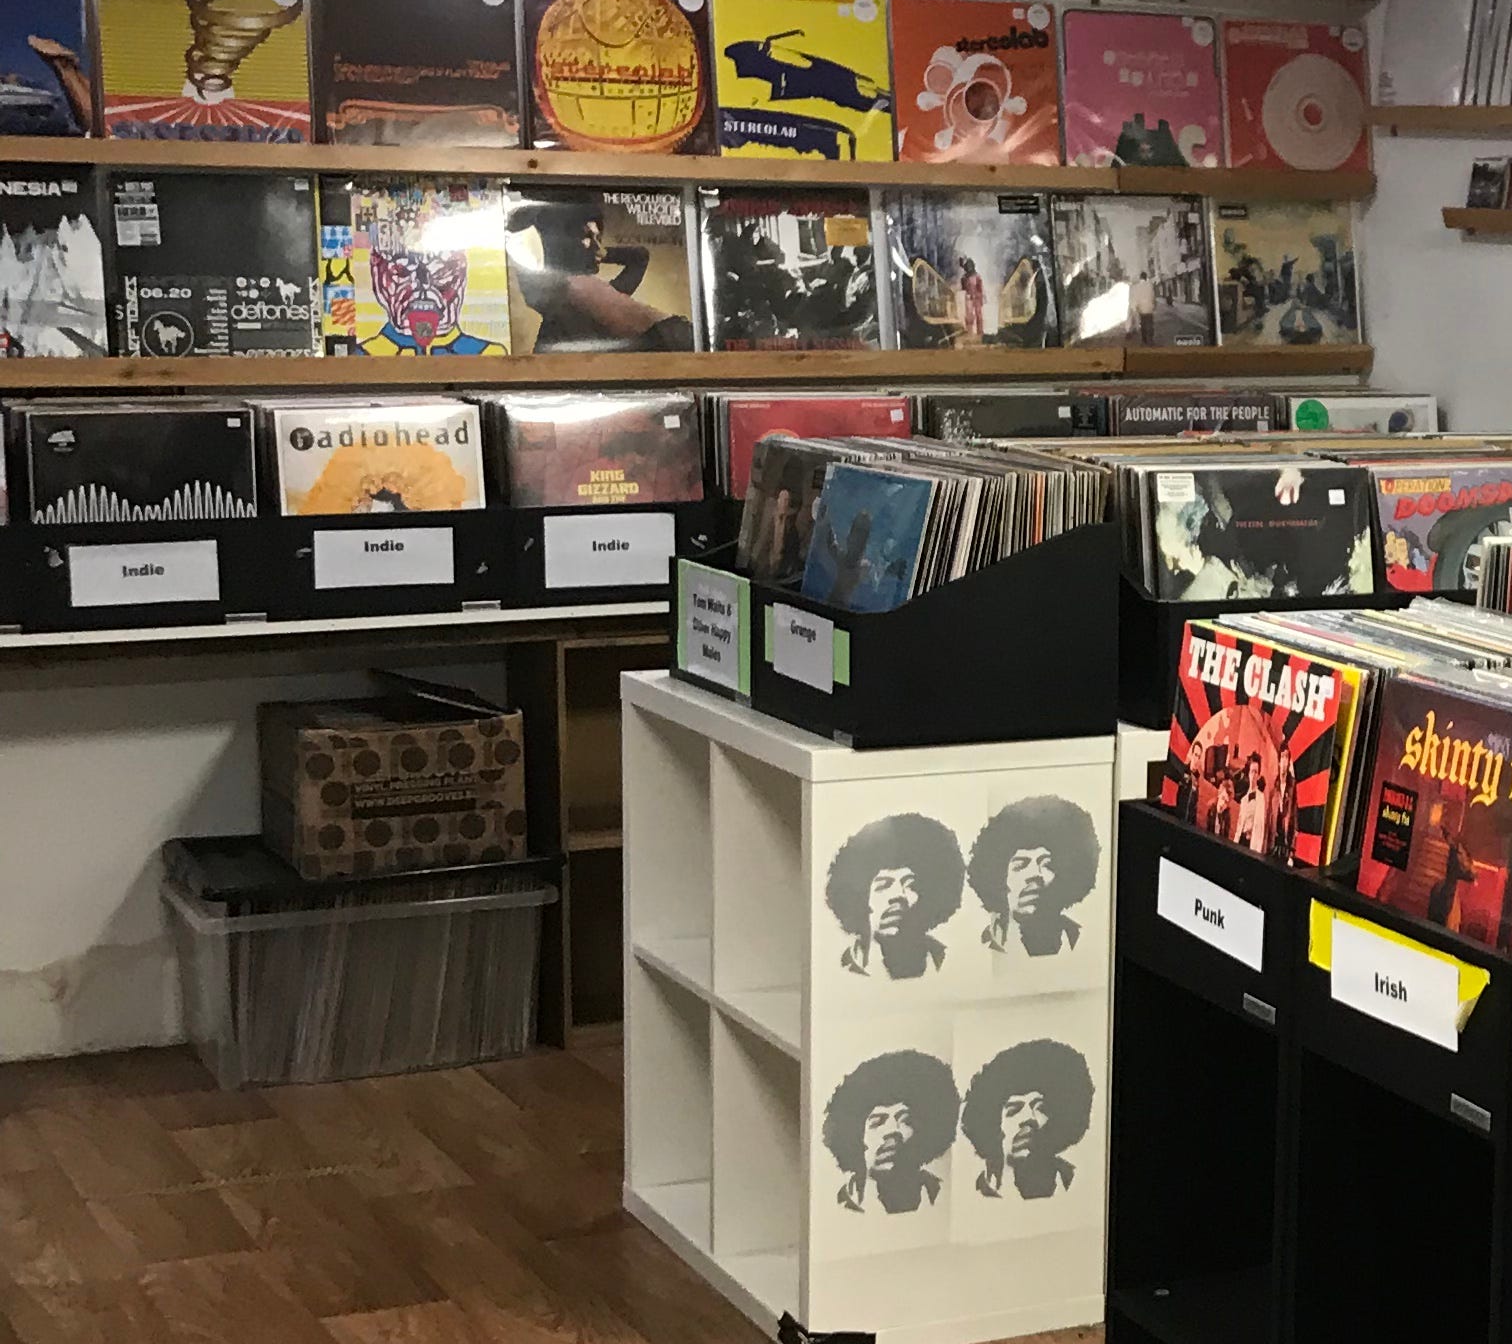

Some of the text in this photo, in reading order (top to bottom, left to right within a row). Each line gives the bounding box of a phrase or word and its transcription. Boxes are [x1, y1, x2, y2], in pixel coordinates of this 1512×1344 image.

[955, 26, 1050, 53] stereolab
[723, 120, 798, 139] STEREOLAB
[230, 303, 310, 321] deftones
[1125, 405, 1271, 422] AUTOMATIC FOR THE PEOPLE
[289, 421, 470, 452] radiohead
[589, 469, 625, 483] KING
[577, 482, 639, 497] GIZZARD
[364, 540, 405, 554] Indie
[592, 539, 631, 553] Indie
[122, 563, 165, 579] Indie
[790, 619, 817, 643] Grunge
[1187, 636, 1337, 723] THE CLASH
[1399, 710, 1505, 810] skinty
[1194, 896, 1226, 932] Punk
[1374, 971, 1409, 1004] Irish
